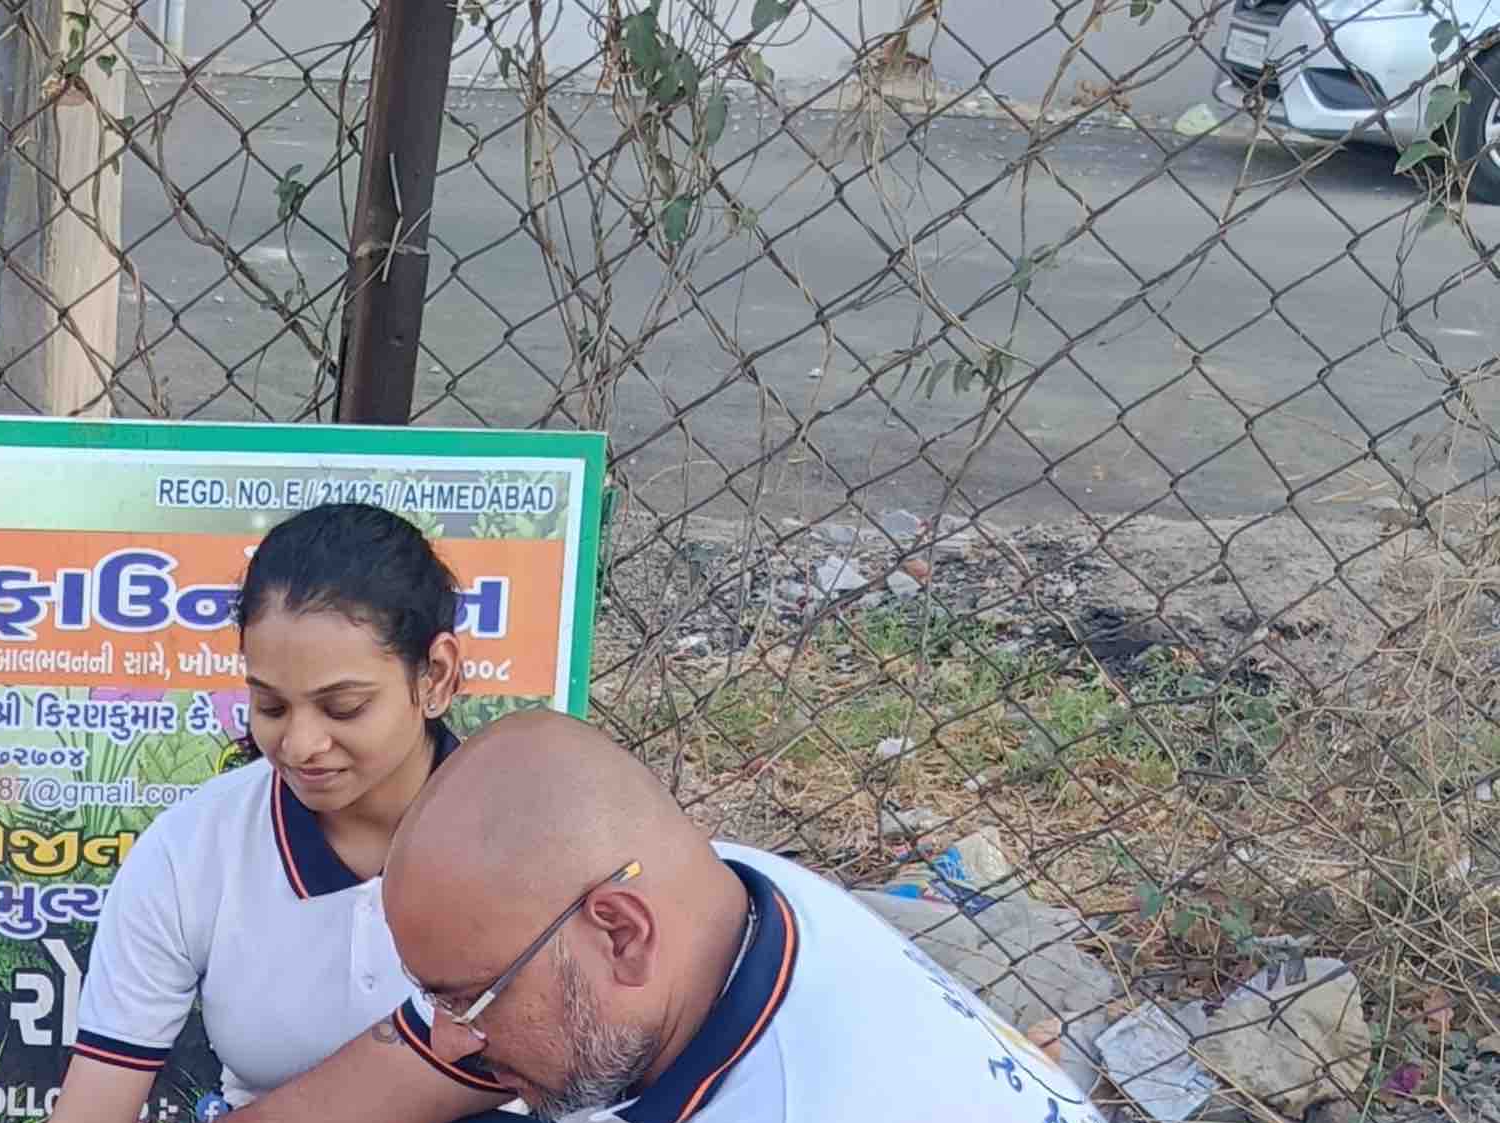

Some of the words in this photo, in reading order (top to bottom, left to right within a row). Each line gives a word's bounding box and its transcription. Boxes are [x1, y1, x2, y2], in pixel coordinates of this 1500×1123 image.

[159, 479, 230, 508] REGD.
[238, 481, 279, 508] NO.
[320, 484, 384, 510] 21425
[403, 486, 554, 512] AHMEDABAD
[36, 692, 175, 740] કિરણકુમાર
